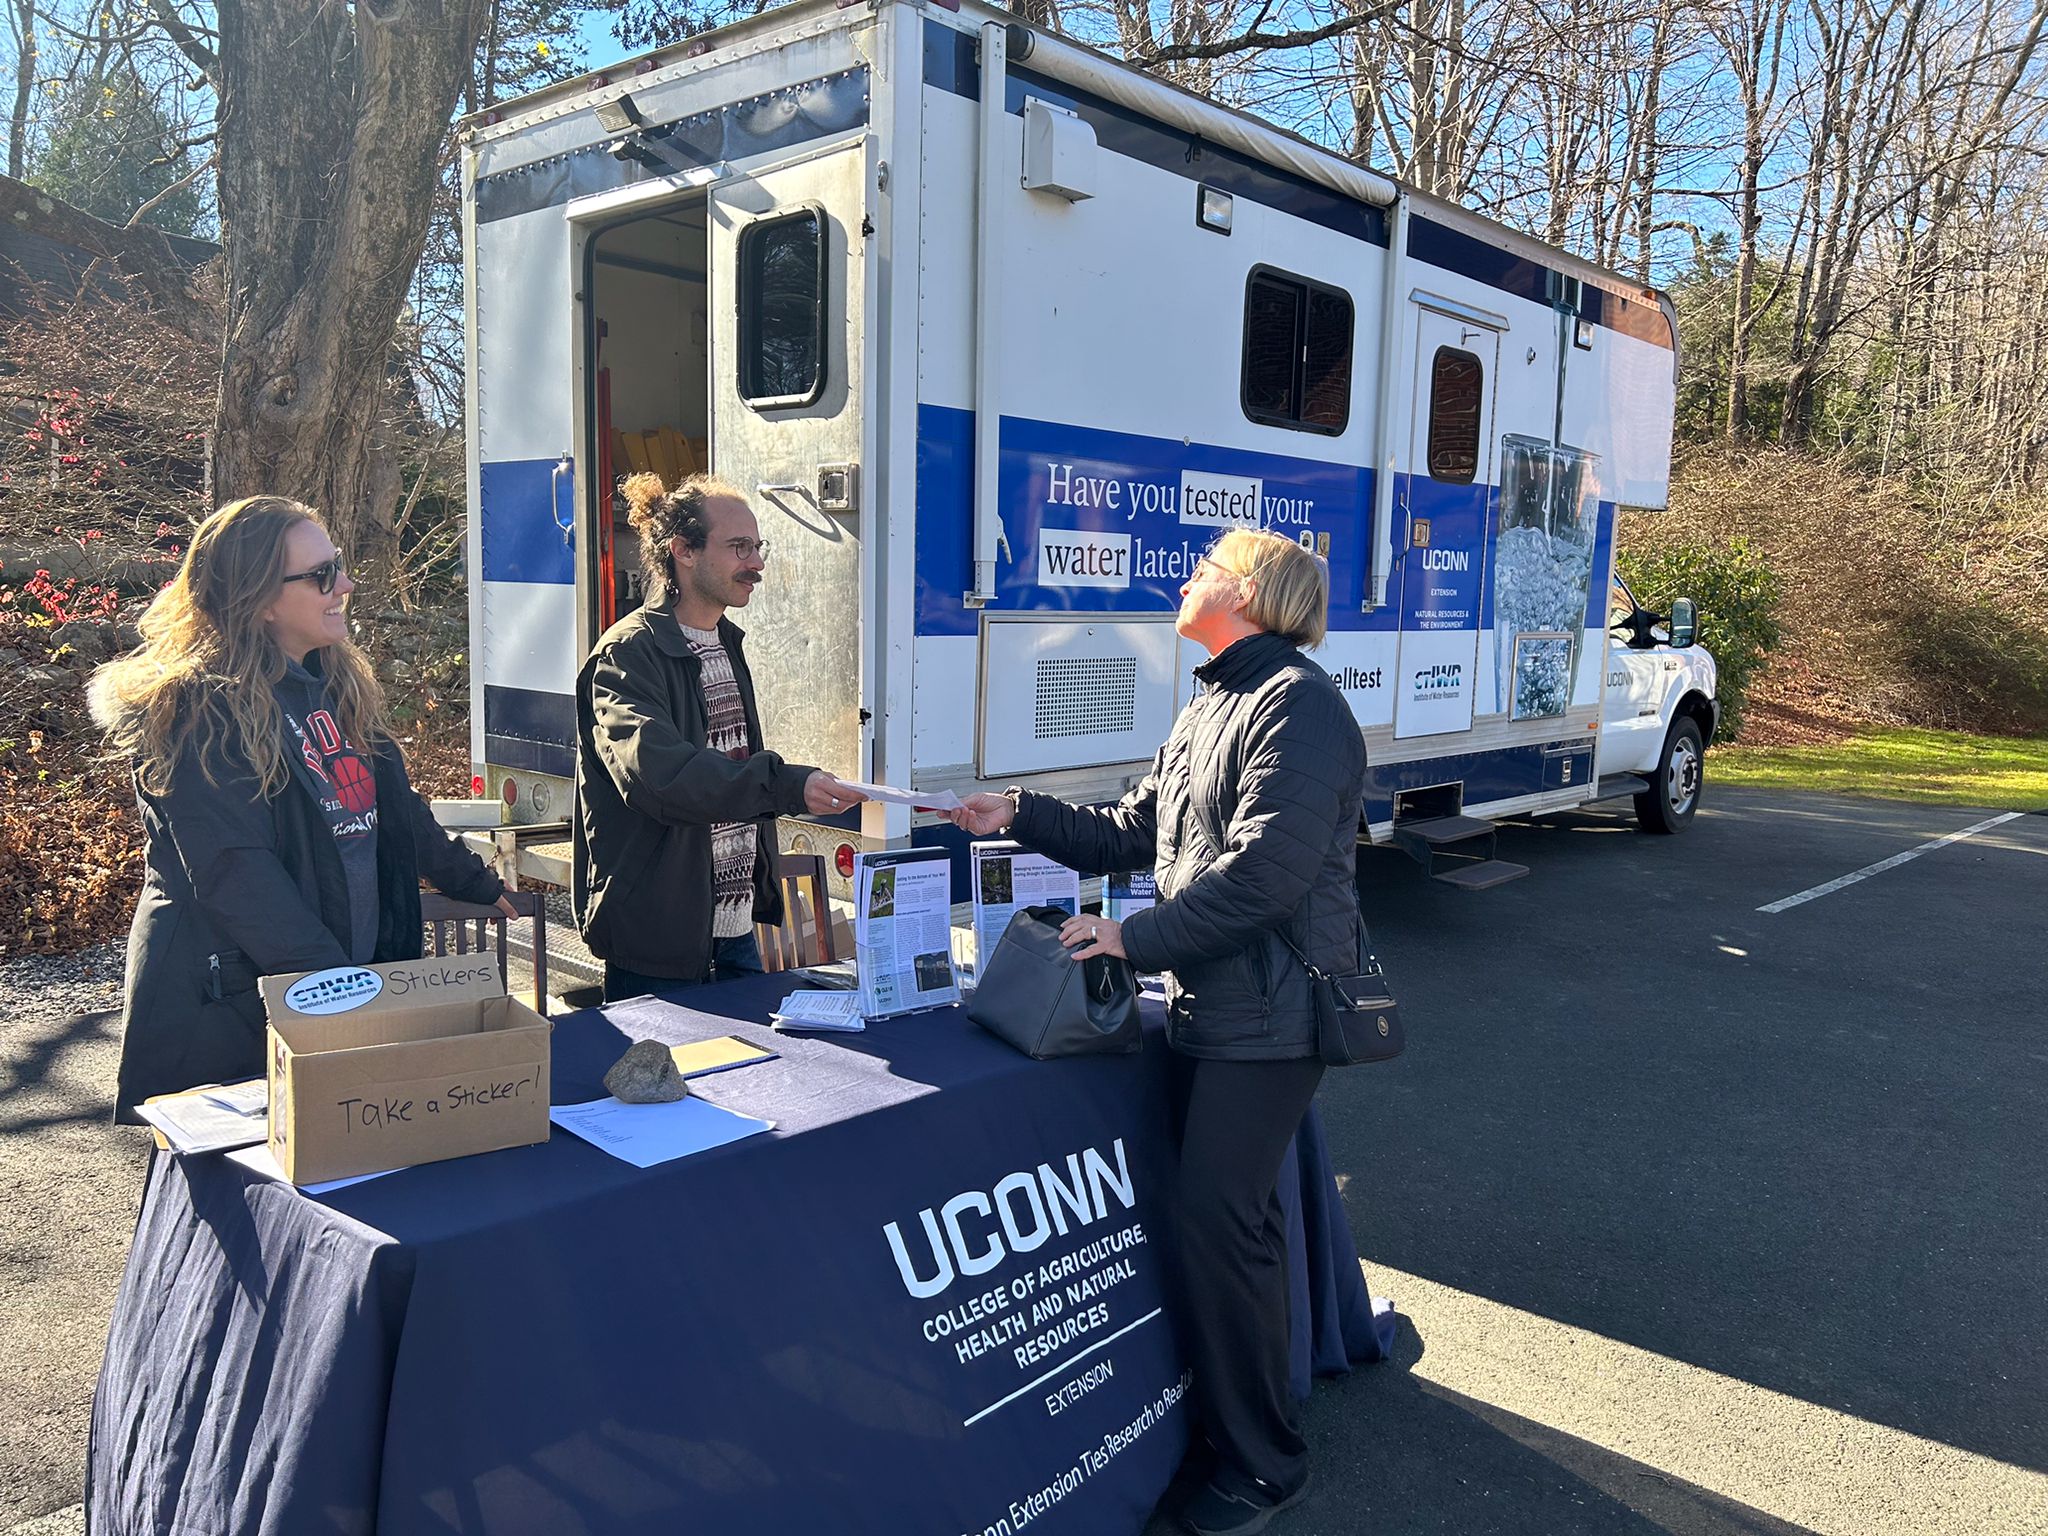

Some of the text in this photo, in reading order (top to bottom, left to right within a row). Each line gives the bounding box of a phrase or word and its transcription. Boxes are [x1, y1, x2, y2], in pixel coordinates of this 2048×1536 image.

[1047, 463, 1314, 527] Have you tested your
[1045, 543, 1127, 576] water
[1422, 549, 1469, 572] UCONN
[1431, 588, 1458, 597] EXTENSION
[1415, 610, 1438, 618] NATURAL
[1438, 610, 1465, 618] RESOURCES
[1420, 621, 1464, 629] THE ENVIRONMENT
[1330, 667, 1382, 690] elltest
[1607, 672, 1634, 688] UCONN
[1130, 874, 1155, 882] The Co
[1130, 881, 1155, 889] Institut
[388, 966, 492, 995] Stickers
[298, 1000, 324, 1010] Institute
[330, 993, 348, 1002] Water
[348, 986, 377, 998] Resources
[337, 1065, 541, 1133] Take a Sticker!
[882, 1138, 1136, 1299] UCONN
[922, 1223, 1148, 1343] COLLEGE OF AGRICULTURE,
[955, 1258, 1136, 1364] HEALTH AND NATURAL
[1014, 1302, 1109, 1369] RESOURCES
[1045, 1359, 1114, 1416] EXTENSION
[1008, 1466, 1084, 1530] Extension
[1079, 1446, 1109, 1477] Ties
[1103, 1404, 1155, 1458] Research
[1153, 1399, 1165, 1420] to
[1162, 1374, 1184, 1410] Real
